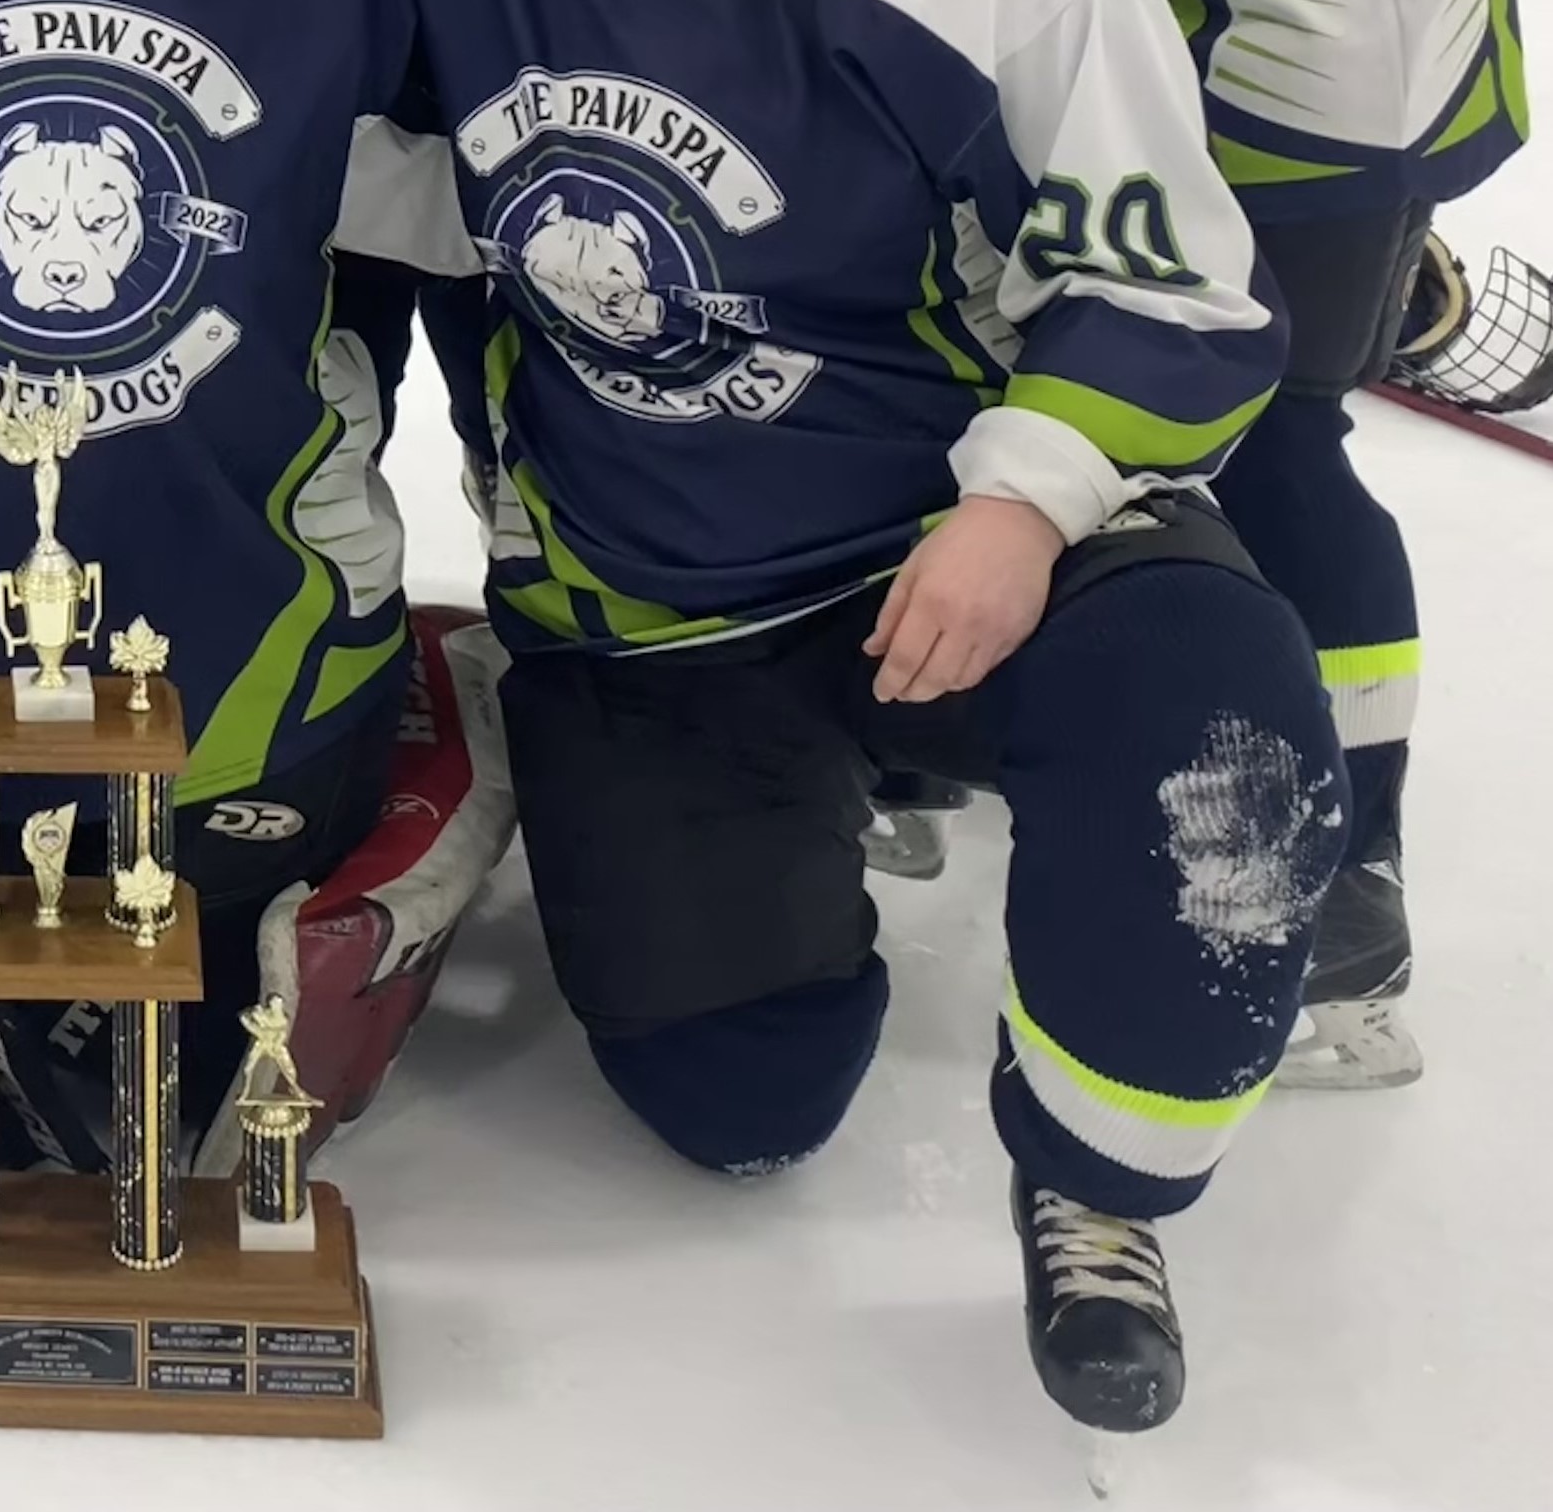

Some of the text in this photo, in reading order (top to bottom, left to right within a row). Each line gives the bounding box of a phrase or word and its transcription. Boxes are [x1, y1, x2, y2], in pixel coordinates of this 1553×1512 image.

[31, 10, 130, 55] PAW
[133, 28, 212, 97] SPA
[569, 85, 652, 138] PAW
[650, 109, 728, 189] SPA
[175, 202, 234, 238] 2022
[1018, 170, 1211, 289] 20
